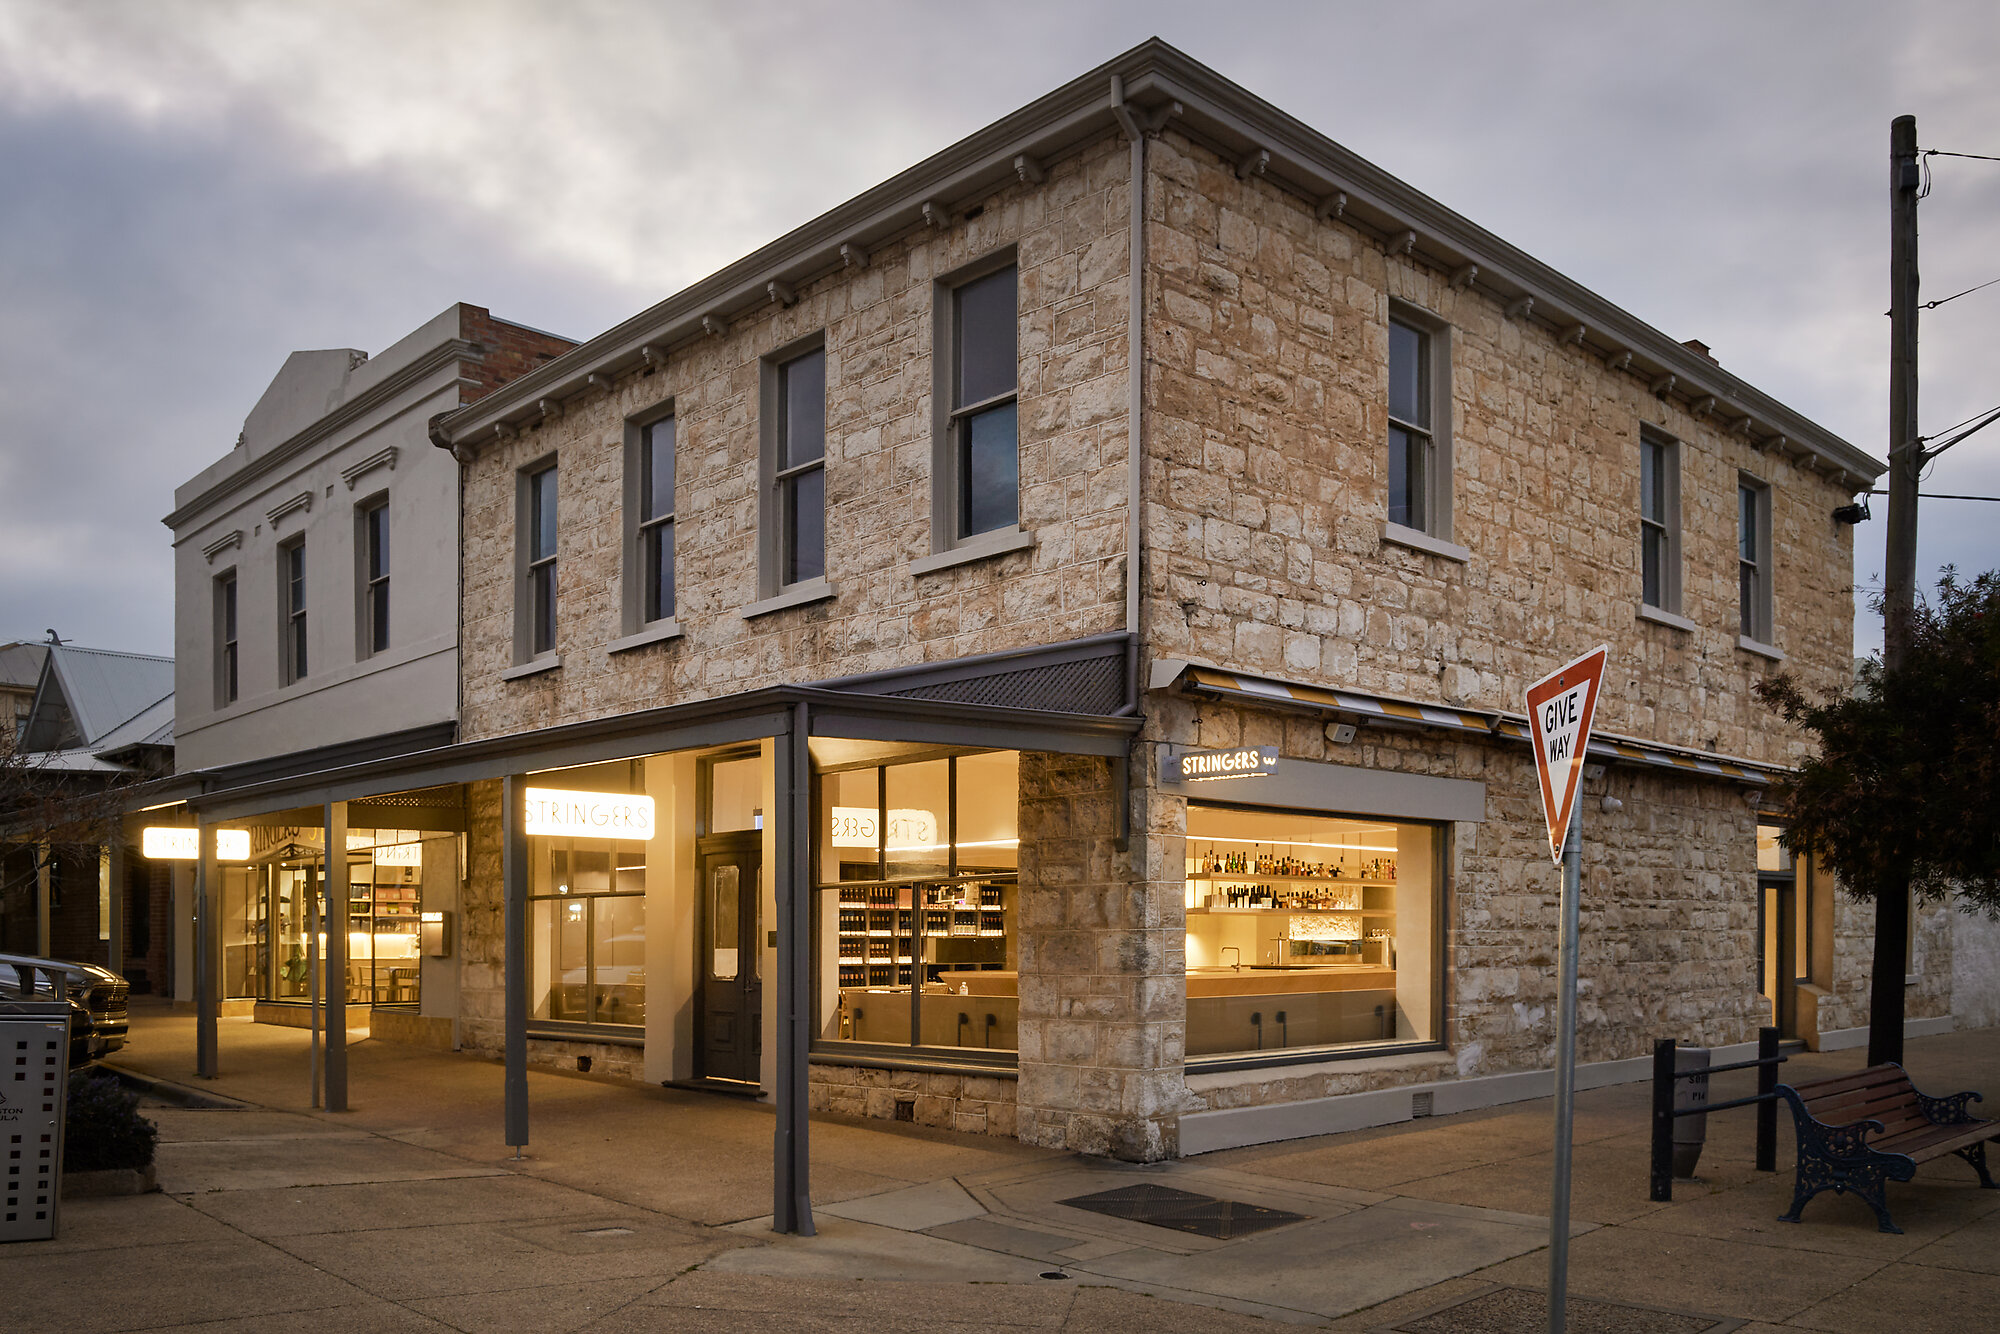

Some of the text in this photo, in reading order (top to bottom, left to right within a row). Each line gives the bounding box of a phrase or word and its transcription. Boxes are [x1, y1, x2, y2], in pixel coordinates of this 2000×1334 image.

[1545, 691, 1577, 733] GIVE
[1182, 750, 1259, 775] STRINGERS
[1550, 732, 1570, 763] WAY
[526, 799, 648, 829] STRINGERS
